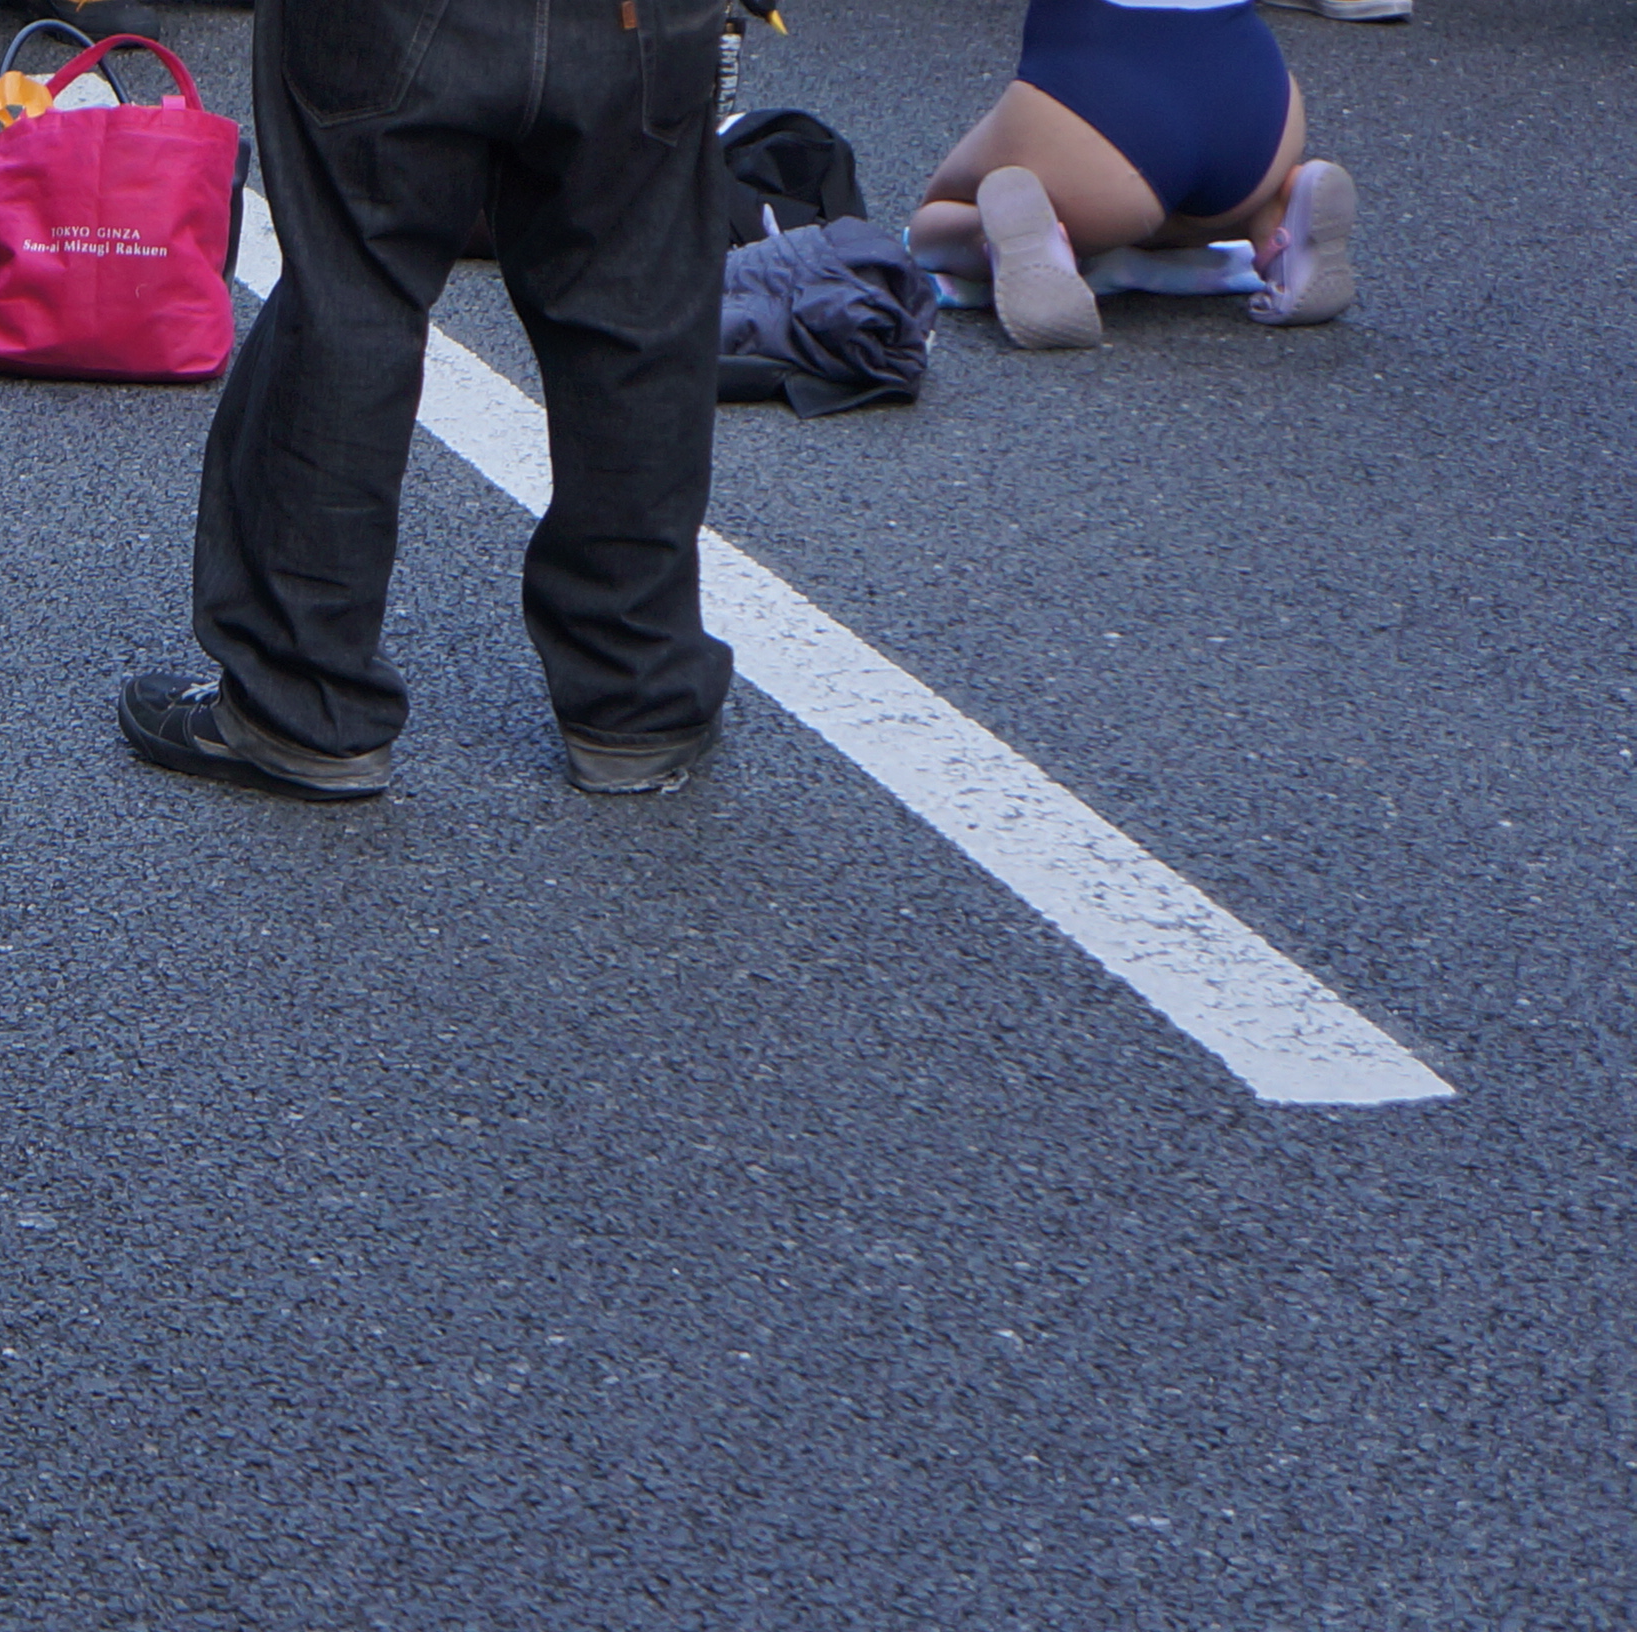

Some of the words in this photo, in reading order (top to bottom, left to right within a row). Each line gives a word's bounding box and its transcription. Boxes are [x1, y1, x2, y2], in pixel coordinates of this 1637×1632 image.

[51, 227, 90, 238] TOKYO
[97, 227, 141, 240] GINZA
[64, 240, 110, 257] Mizugi
[116, 241, 168, 257] Rakuen
